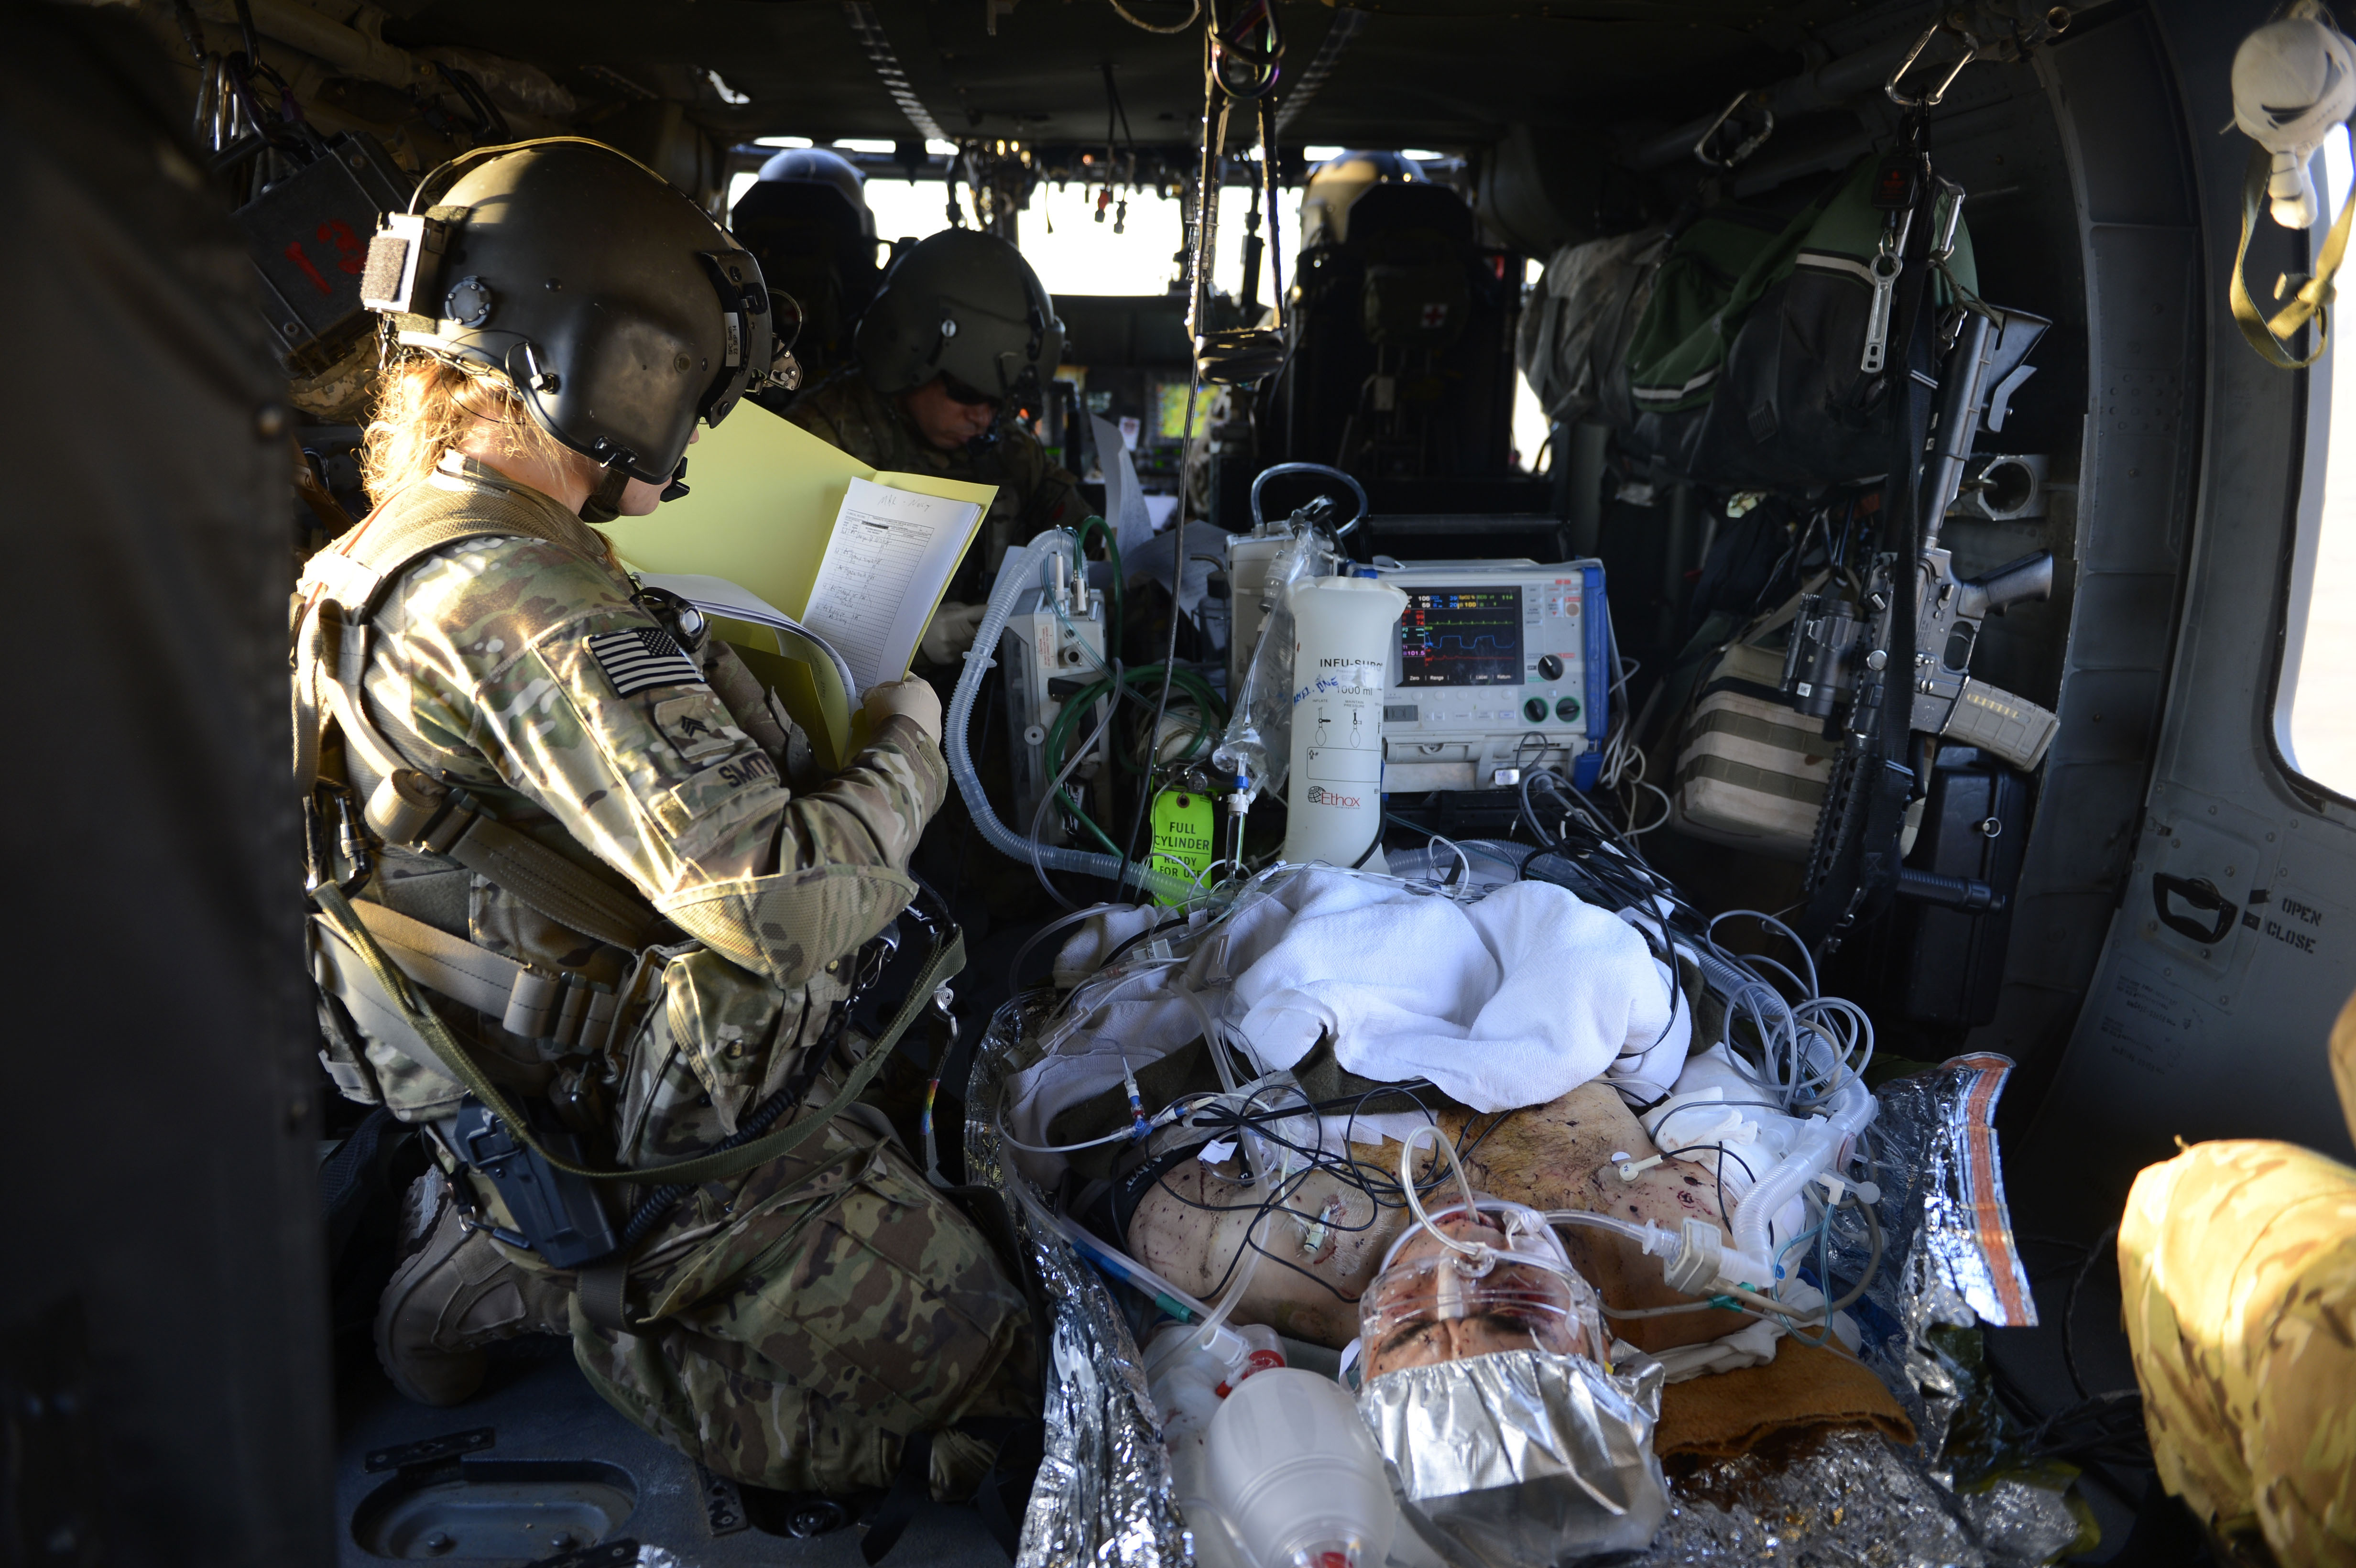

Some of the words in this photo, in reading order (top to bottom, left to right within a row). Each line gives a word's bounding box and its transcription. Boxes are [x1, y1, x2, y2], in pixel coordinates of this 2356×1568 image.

[1337, 686, 1360, 695] 1000
[1363, 687, 1373, 696] ml
[1321, 792, 1360, 807] Ethox
[1169, 821, 1196, 835] FULL
[1155, 835, 1210, 850] CYLINDER
[1159, 866, 1178, 877] FOR
[2281, 897, 2322, 927] OPEN
[2266, 921, 2316, 954] CLOSE
